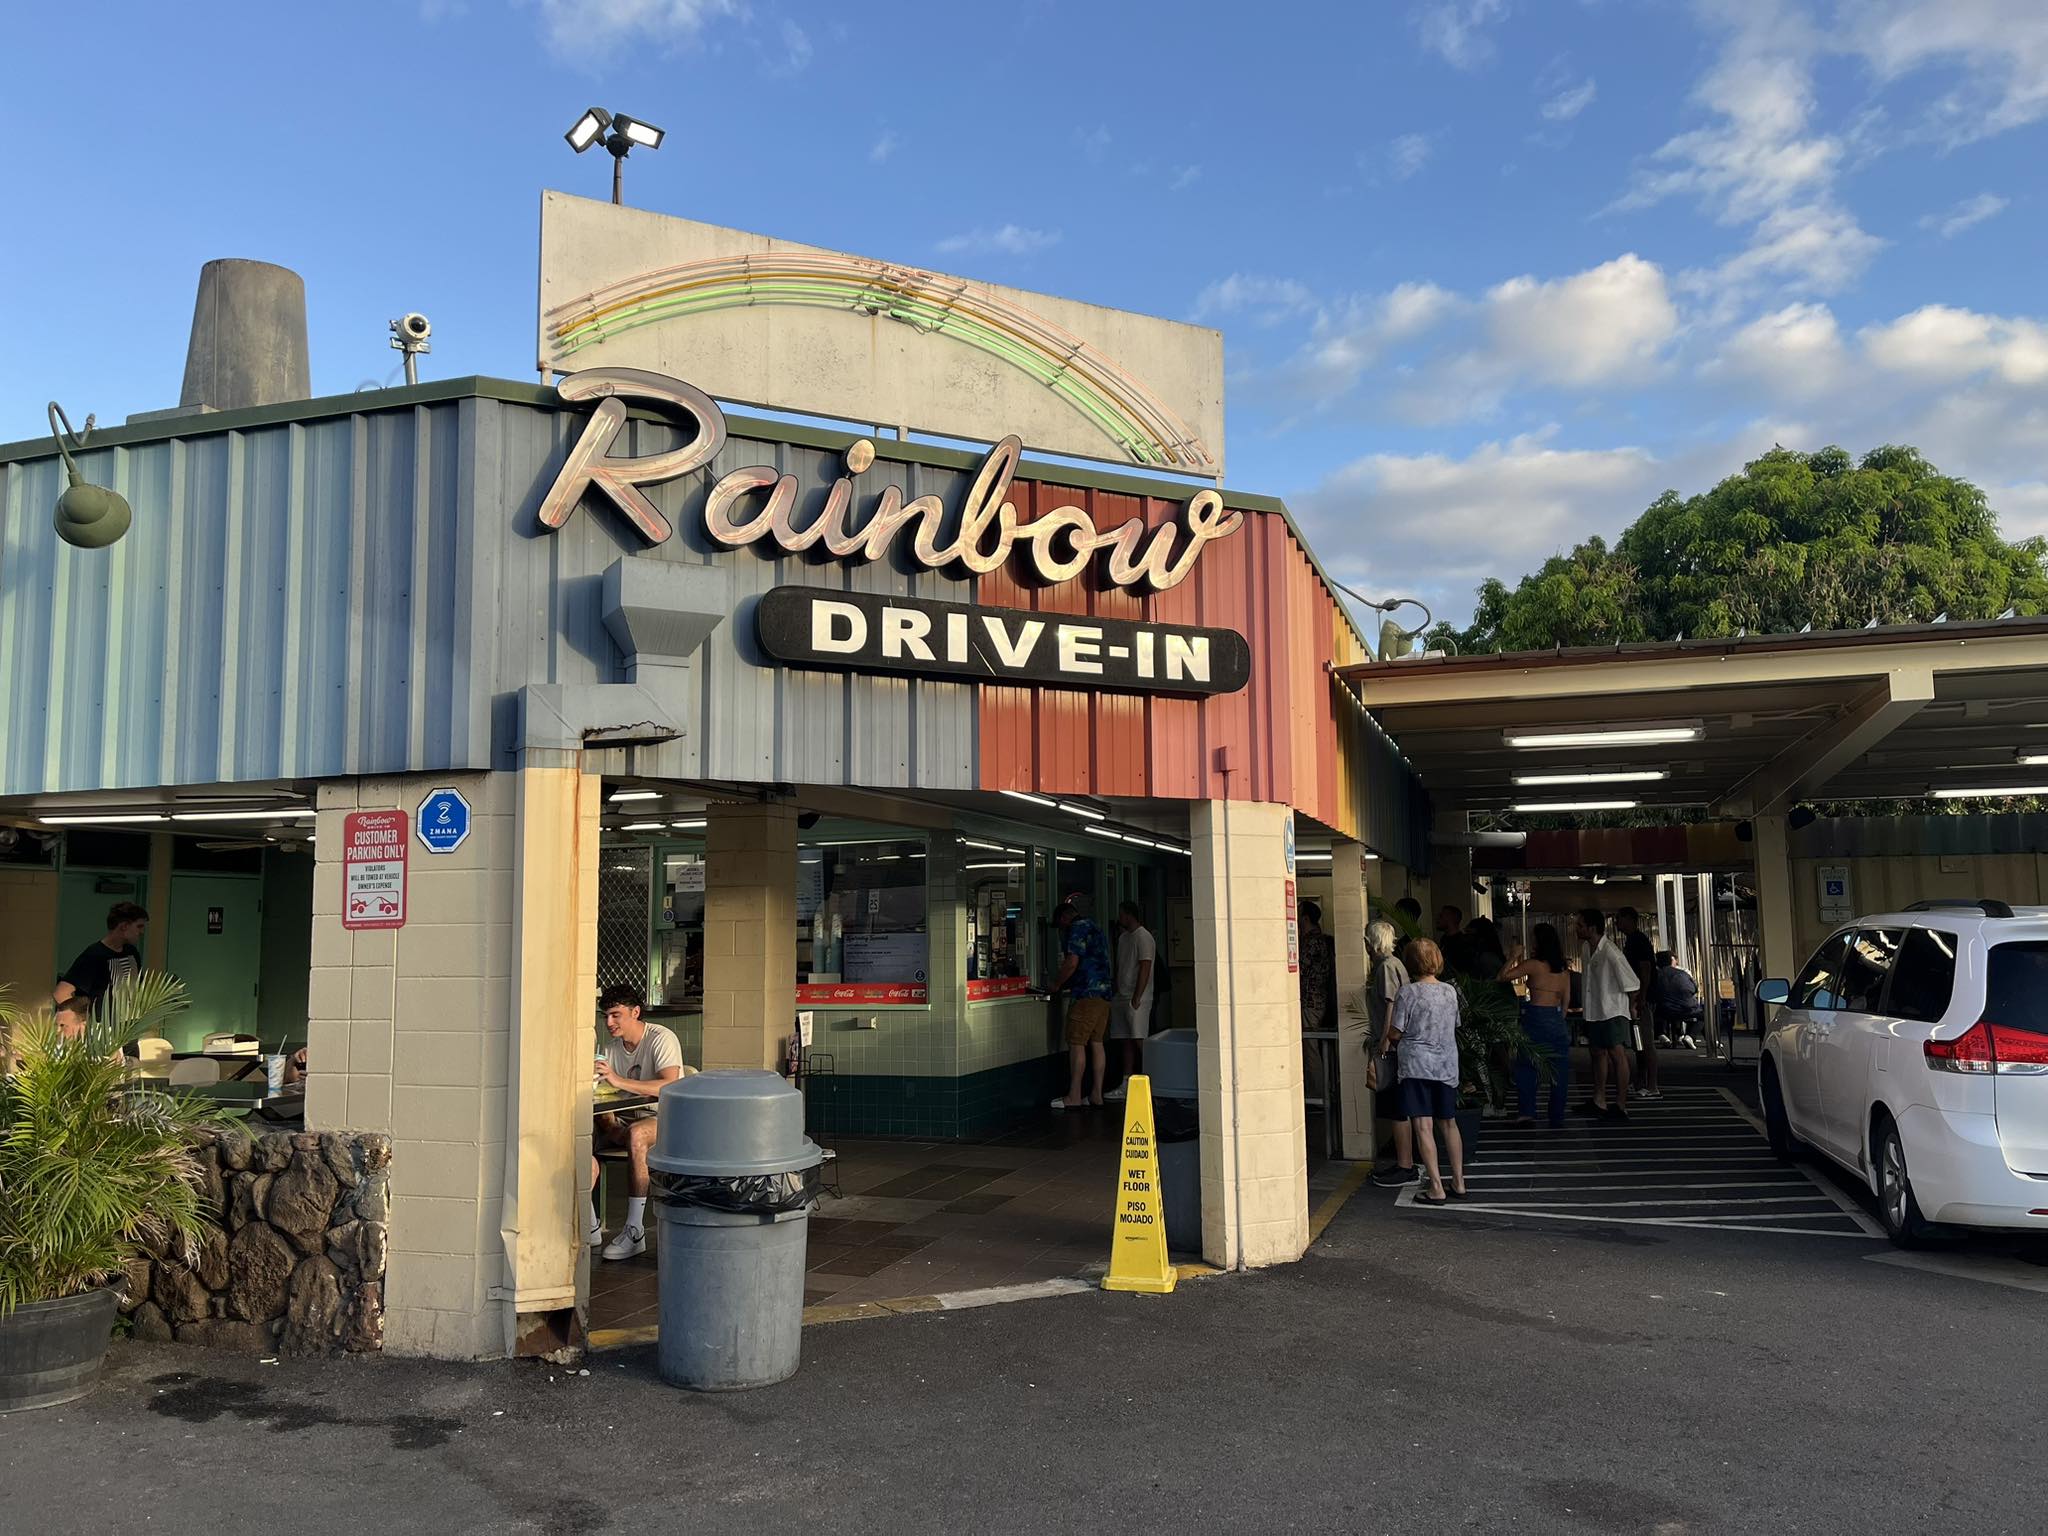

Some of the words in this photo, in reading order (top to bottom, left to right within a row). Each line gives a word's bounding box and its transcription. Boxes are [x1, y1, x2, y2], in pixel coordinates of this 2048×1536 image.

[537, 366, 1243, 591] Rainbow
[810, 598, 1211, 682] DRIVE-IN
[357, 815, 396, 827] Rainbow
[354, 829, 398, 845] CUSTOMER
[347, 845, 383, 860] PARKING
[384, 844, 405, 859] ONLY
[1126, 1136, 1148, 1146] CAUTION
[1125, 1150, 1148, 1159] CUIDADO
[1128, 1169, 1146, 1179] WET
[1123, 1182, 1150, 1192] FLOOR
[1127, 1201, 1146, 1211] PISO
[1120, 1213, 1153, 1224] MOJADO
